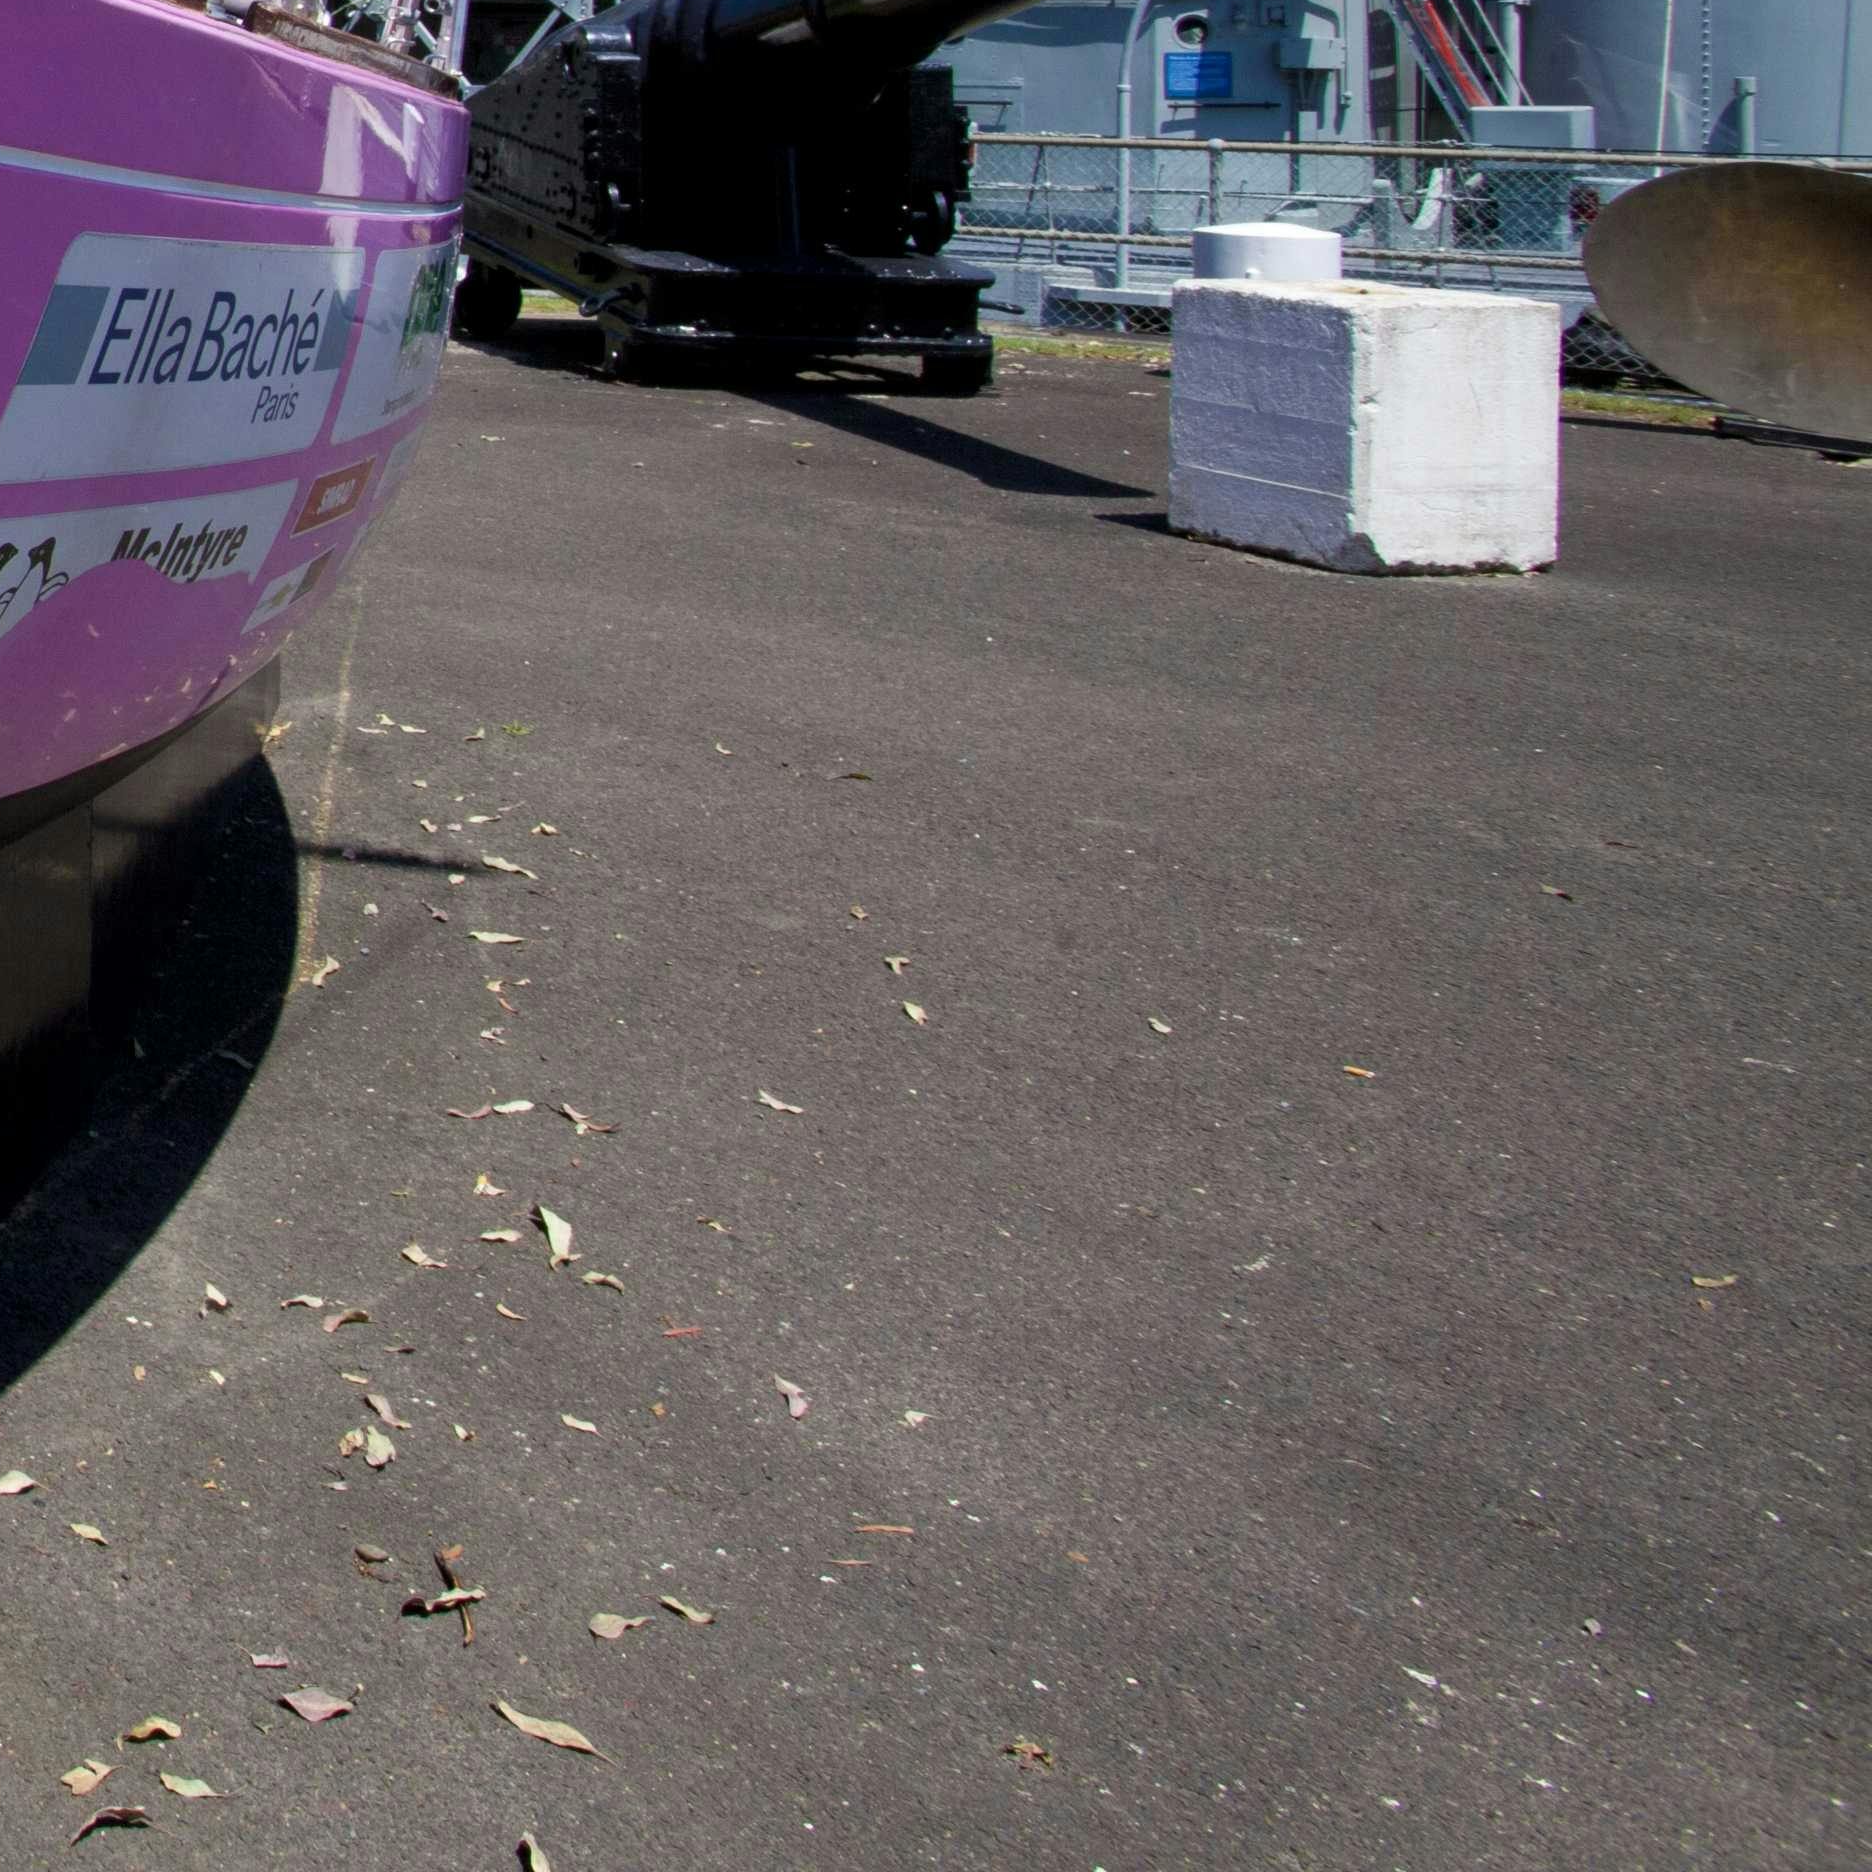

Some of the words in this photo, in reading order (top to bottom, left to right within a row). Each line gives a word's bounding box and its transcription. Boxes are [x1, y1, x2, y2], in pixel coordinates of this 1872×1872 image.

[88, 288, 192, 385] Ella
[188, 288, 325, 382] Baché
[251, 383, 300, 425] Paris
[110, 517, 248, 584] McIntyre
